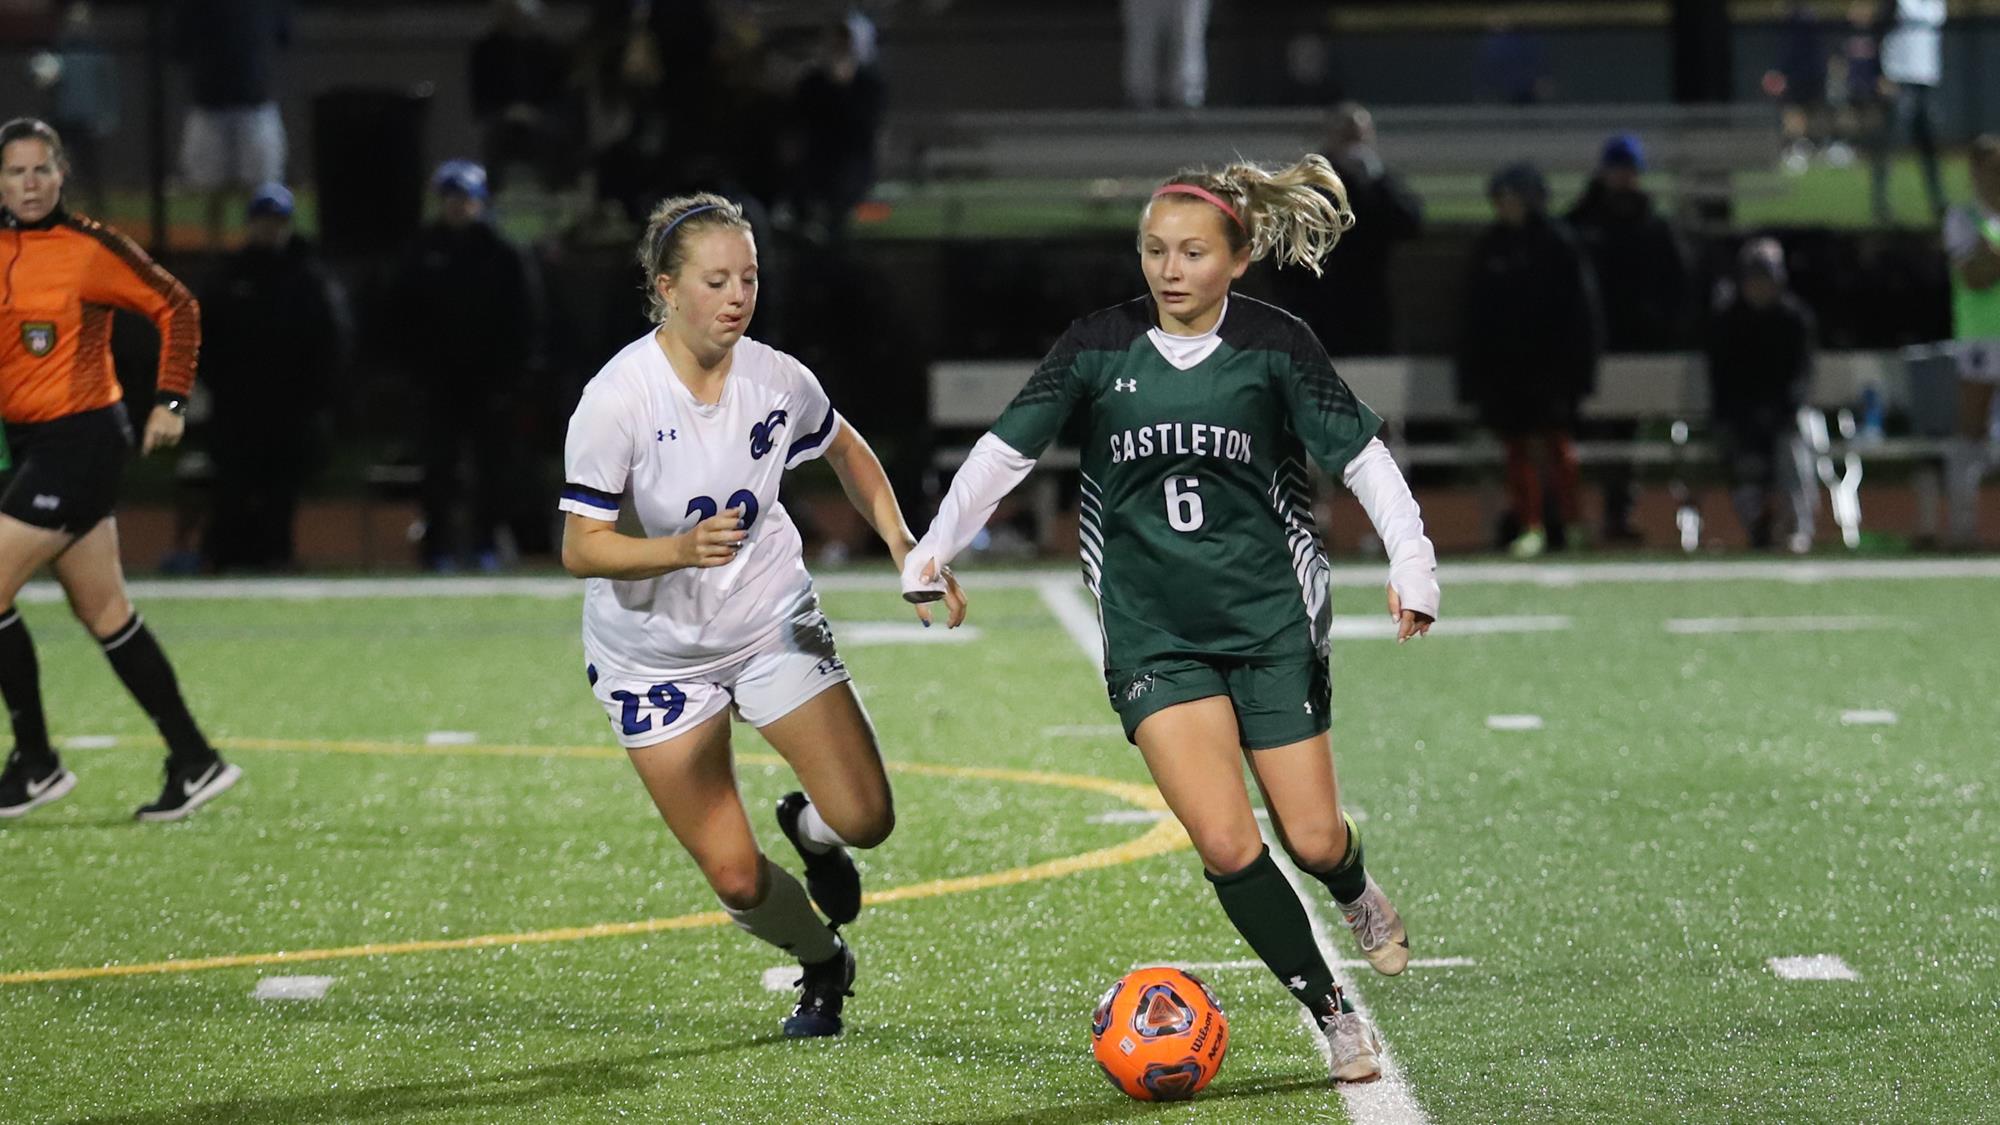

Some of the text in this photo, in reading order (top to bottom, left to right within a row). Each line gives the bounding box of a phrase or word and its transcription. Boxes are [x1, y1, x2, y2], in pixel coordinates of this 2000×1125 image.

[1110, 423, 1251, 464] CASTLETON
[1163, 474, 1205, 532] 6
[610, 682, 687, 736] 29
[1190, 1011, 1213, 1053] Wilson
